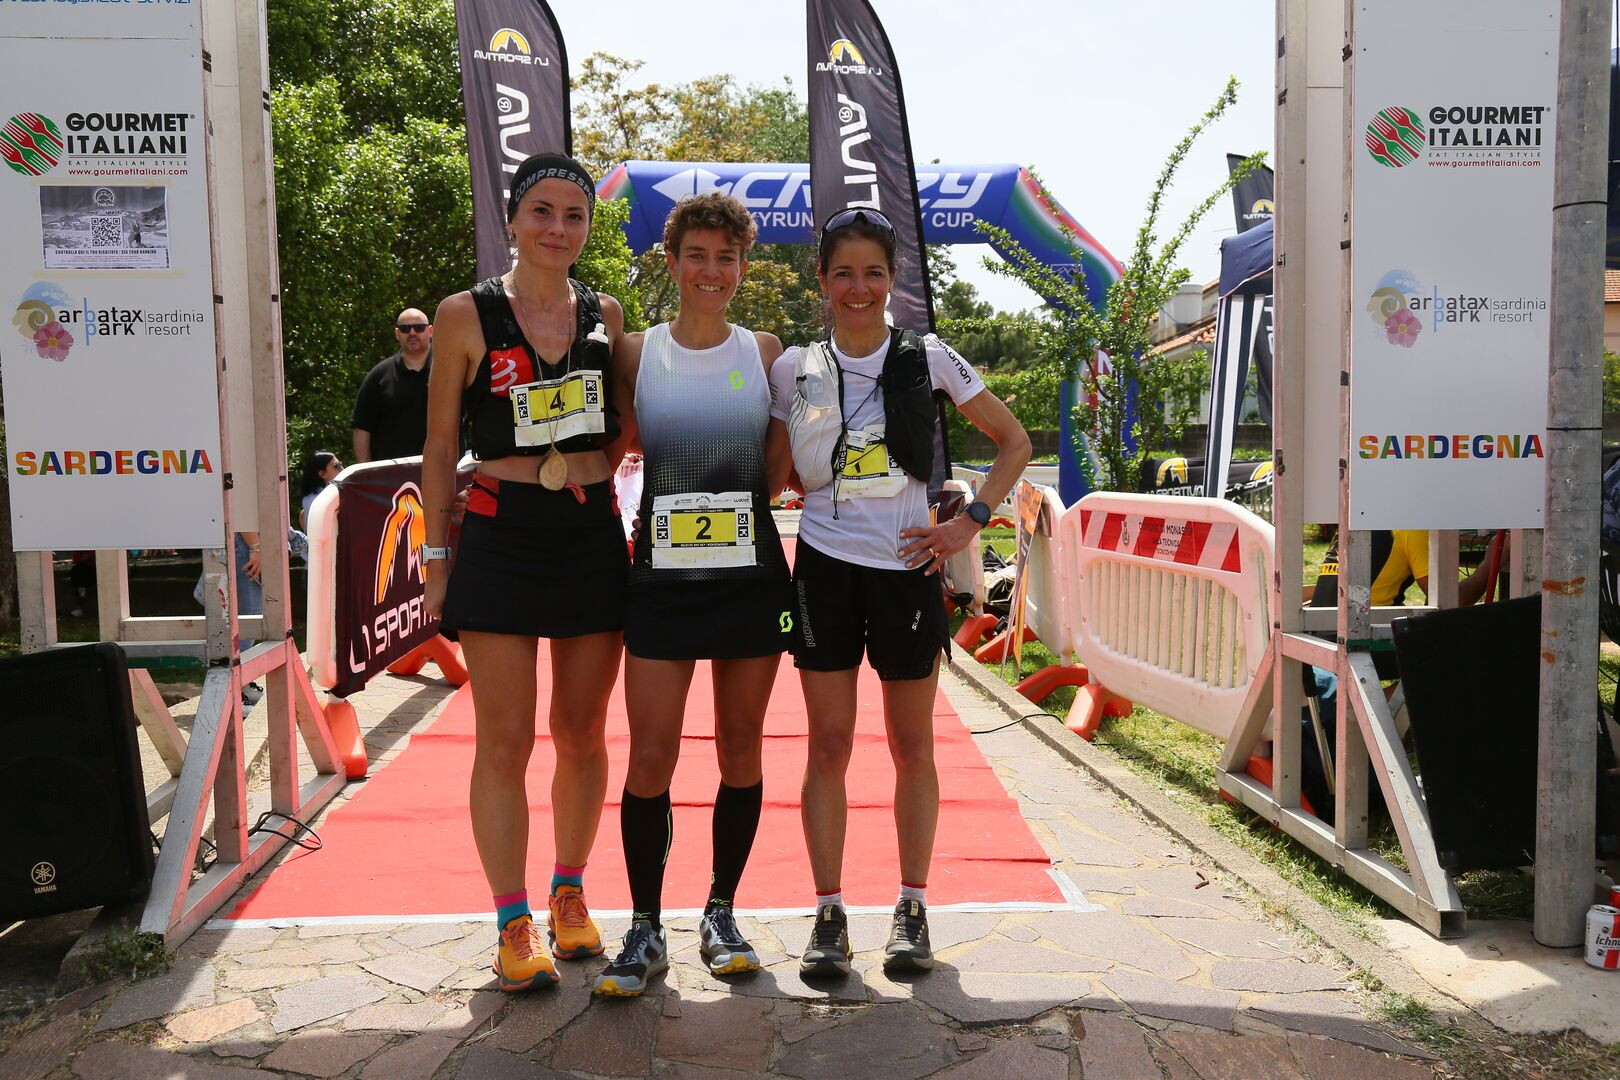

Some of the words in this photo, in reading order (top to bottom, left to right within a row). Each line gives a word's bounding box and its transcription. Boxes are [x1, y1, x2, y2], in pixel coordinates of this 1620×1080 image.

[68, 136, 187, 154] ITALIANI
[1430, 128, 1541, 146] ITALIANI
[68, 168, 188, 176] www.gourmetitaliani.com
[1428, 160, 1541, 168] www.gourmetitaliani.com
[932, 212, 974, 228] CUP
[1410, 285, 1489, 310] arbatax
[1493, 298, 1546, 310] sardinia
[58, 297, 144, 323] arbatax
[147, 310, 204, 323] sardinia
[1434, 308, 1480, 332] park
[1493, 312, 1533, 322] resort
[86, 321, 135, 346] park
[148, 324, 191, 336] resort
[550, 390, 566, 412] 4
[1359, 434, 1544, 460] SARDEGNA
[15, 450, 213, 476] SARDEGNA
[696, 516, 712, 540] 2
[34, 884, 57, 894] YAMAHA
